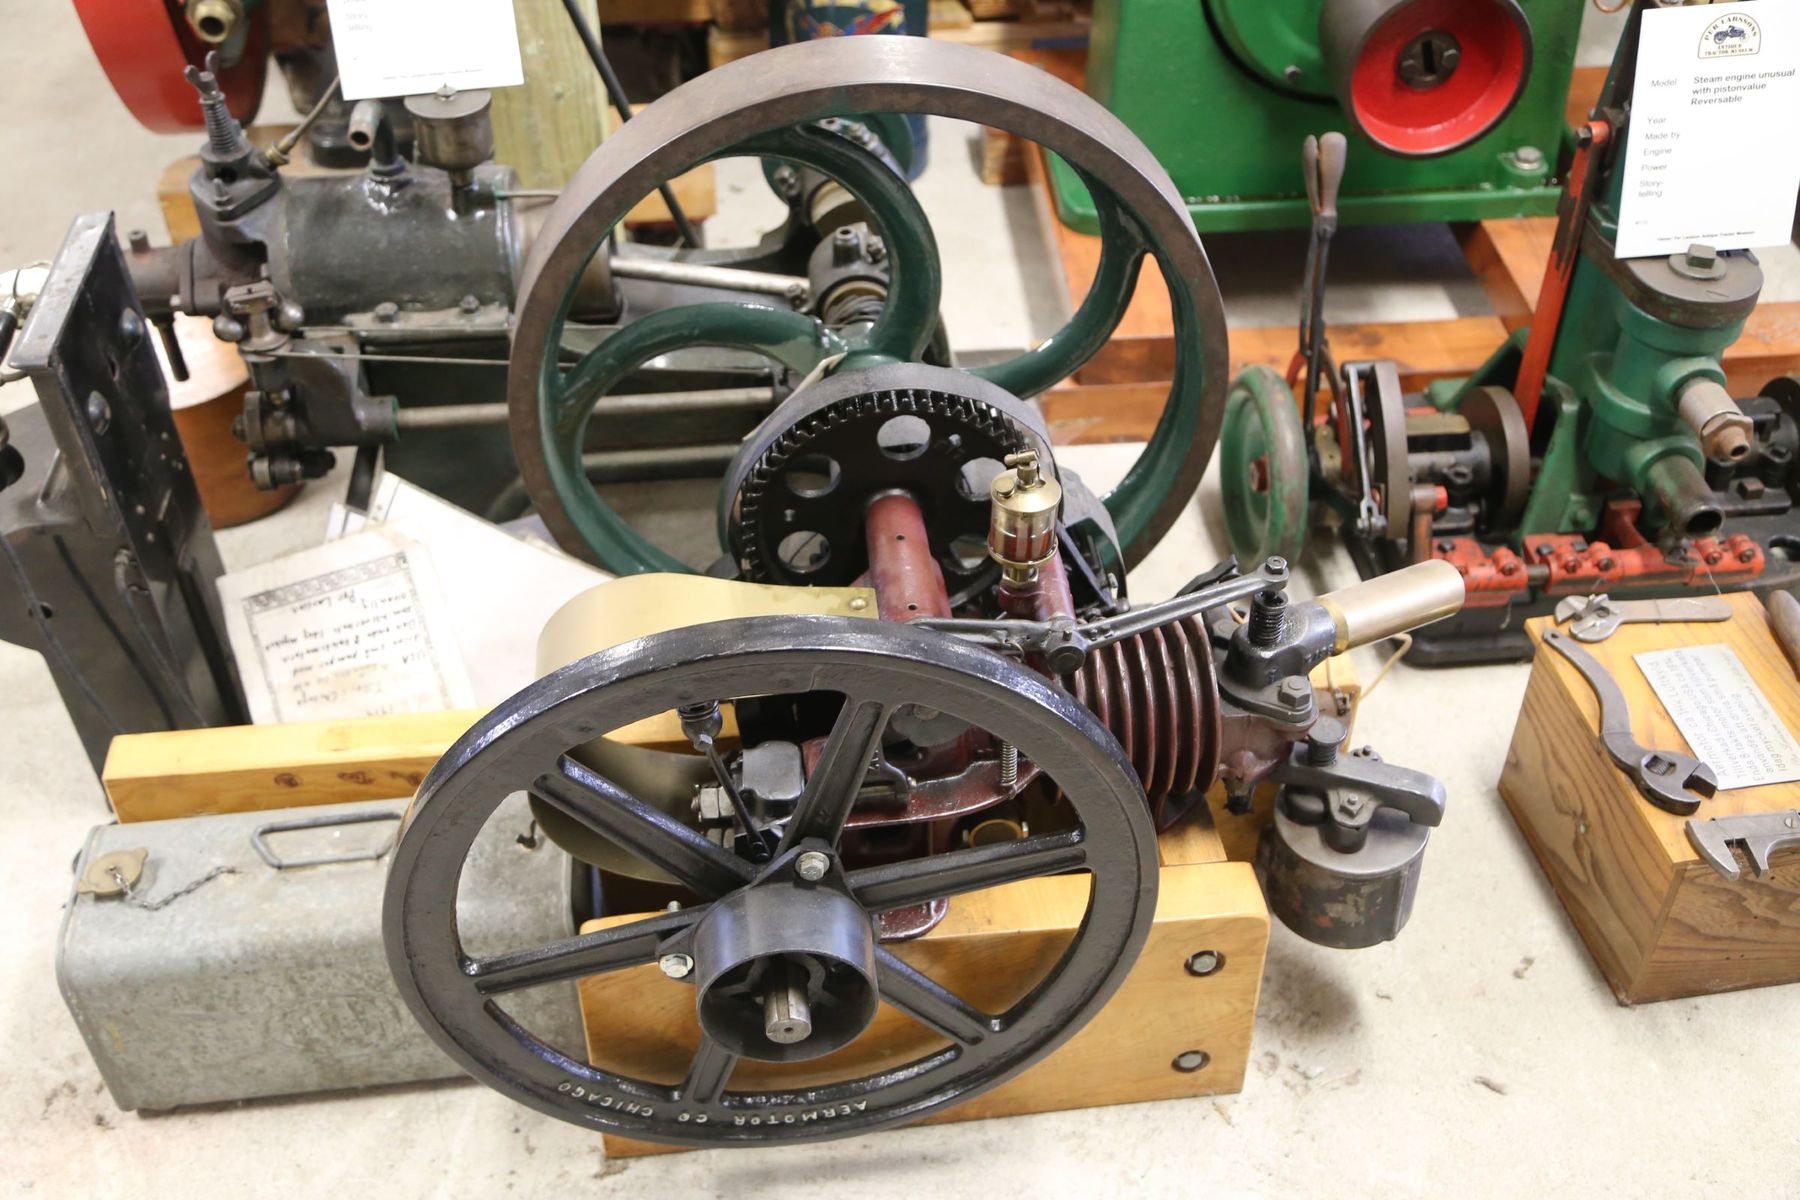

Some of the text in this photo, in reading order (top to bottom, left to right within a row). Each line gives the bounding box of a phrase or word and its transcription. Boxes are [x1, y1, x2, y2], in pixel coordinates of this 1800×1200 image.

[1704, 24, 1719, 41] PER
[1650, 68, 1796, 88] Model Steam engine unusual
[1692, 82, 1767, 96] with pistonvalue
[1690, 94, 1743, 106] Reversable
[1647, 116, 1667, 125] Year
[1645, 131, 1681, 141] Made by
[1643, 147, 1672, 157] Engine
[1641, 163, 1668, 172] Power
[1638, 189, 1663, 198] telling
[558, 1082, 867, 1126] AERMOTOR CO CHICAGO
